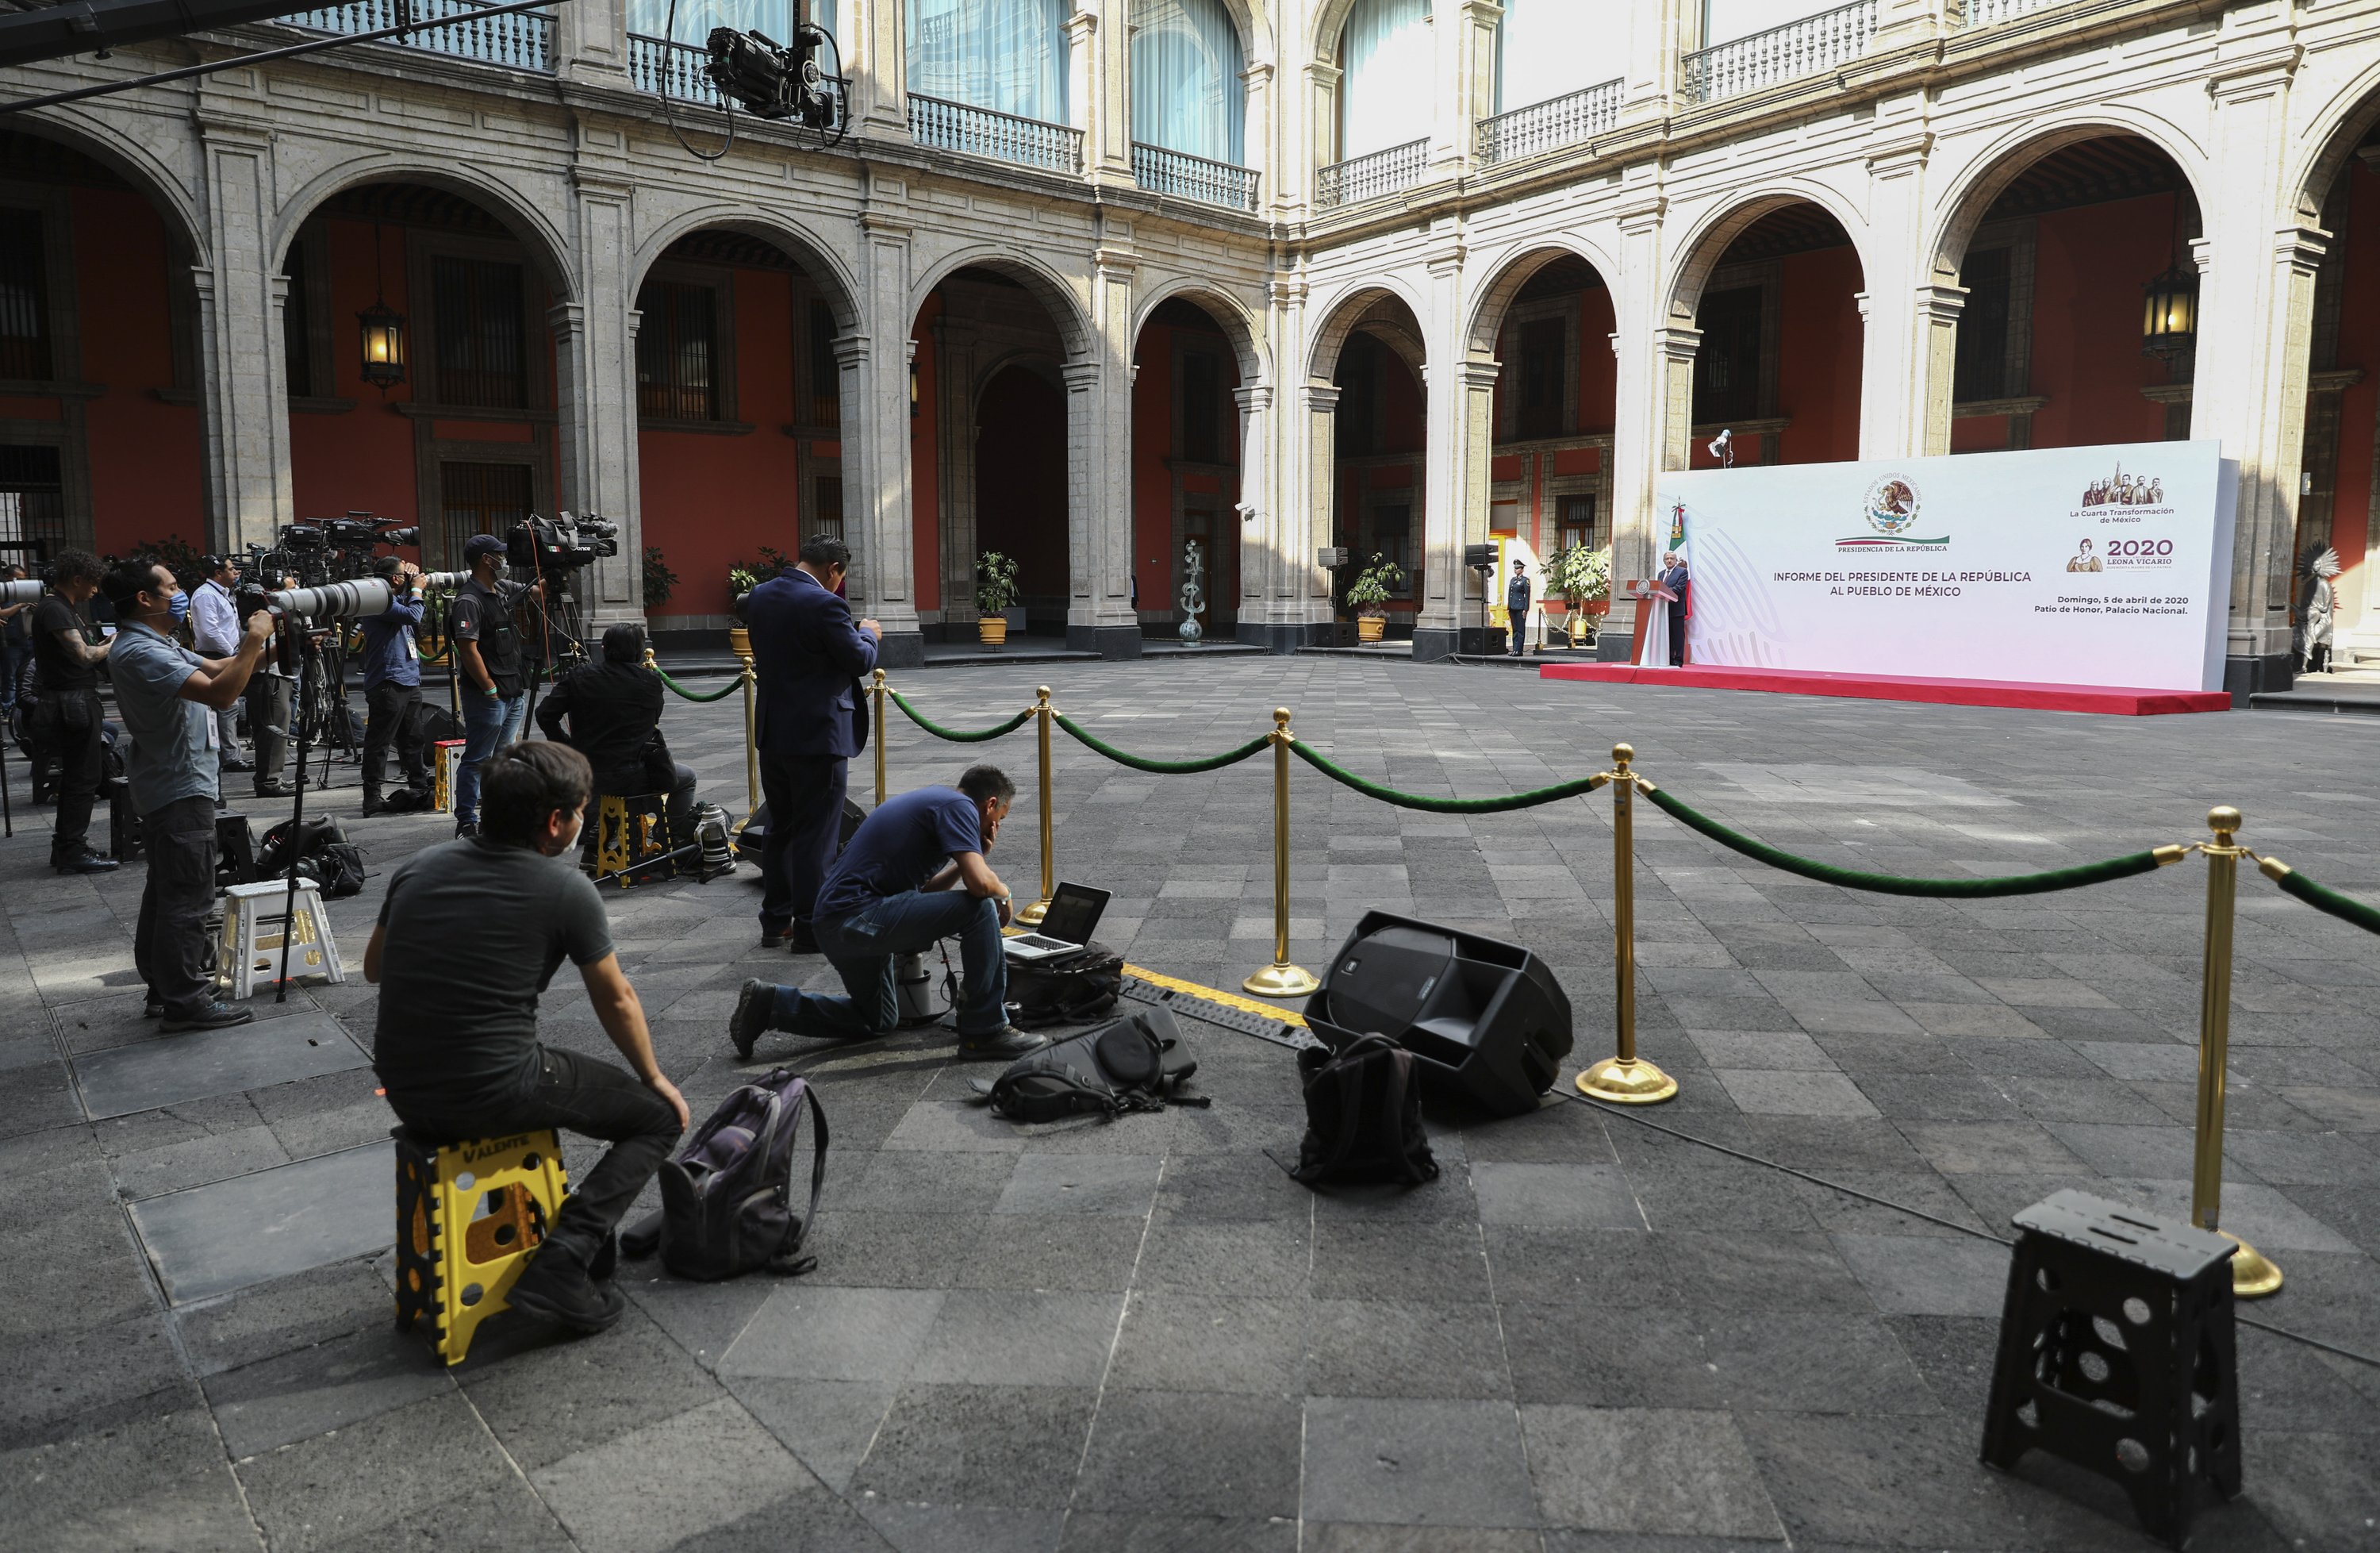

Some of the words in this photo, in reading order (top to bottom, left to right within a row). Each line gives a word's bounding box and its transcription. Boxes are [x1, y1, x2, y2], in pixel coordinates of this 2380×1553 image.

[1863, 479, 1879, 503] ESTADOS
[1879, 472, 1900, 482] UNIDOS
[1902, 474, 1922, 502] MEXICANOS
[2109, 507, 2174, 516] Transformación
[2107, 540, 2174, 555] 2020
[1774, 572, 1821, 582] INFORME
[1825, 572, 1845, 582] DEL
[1848, 571, 1918, 582] PRESIDENTE
[1921, 571, 1938, 582] DE
[1941, 571, 1956, 582] LA
[1960, 569, 2032, 582] REPÚBLICA
[1830, 586, 1844, 596] AL
[1847, 586, 1892, 596] PUEBLO
[1895, 586, 1911, 596] DE
[1914, 584, 1961, 597] MÉXICO
[2057, 596, 2102, 605] Domingo,
[463, 1135, 530, 1164] VALENTE
